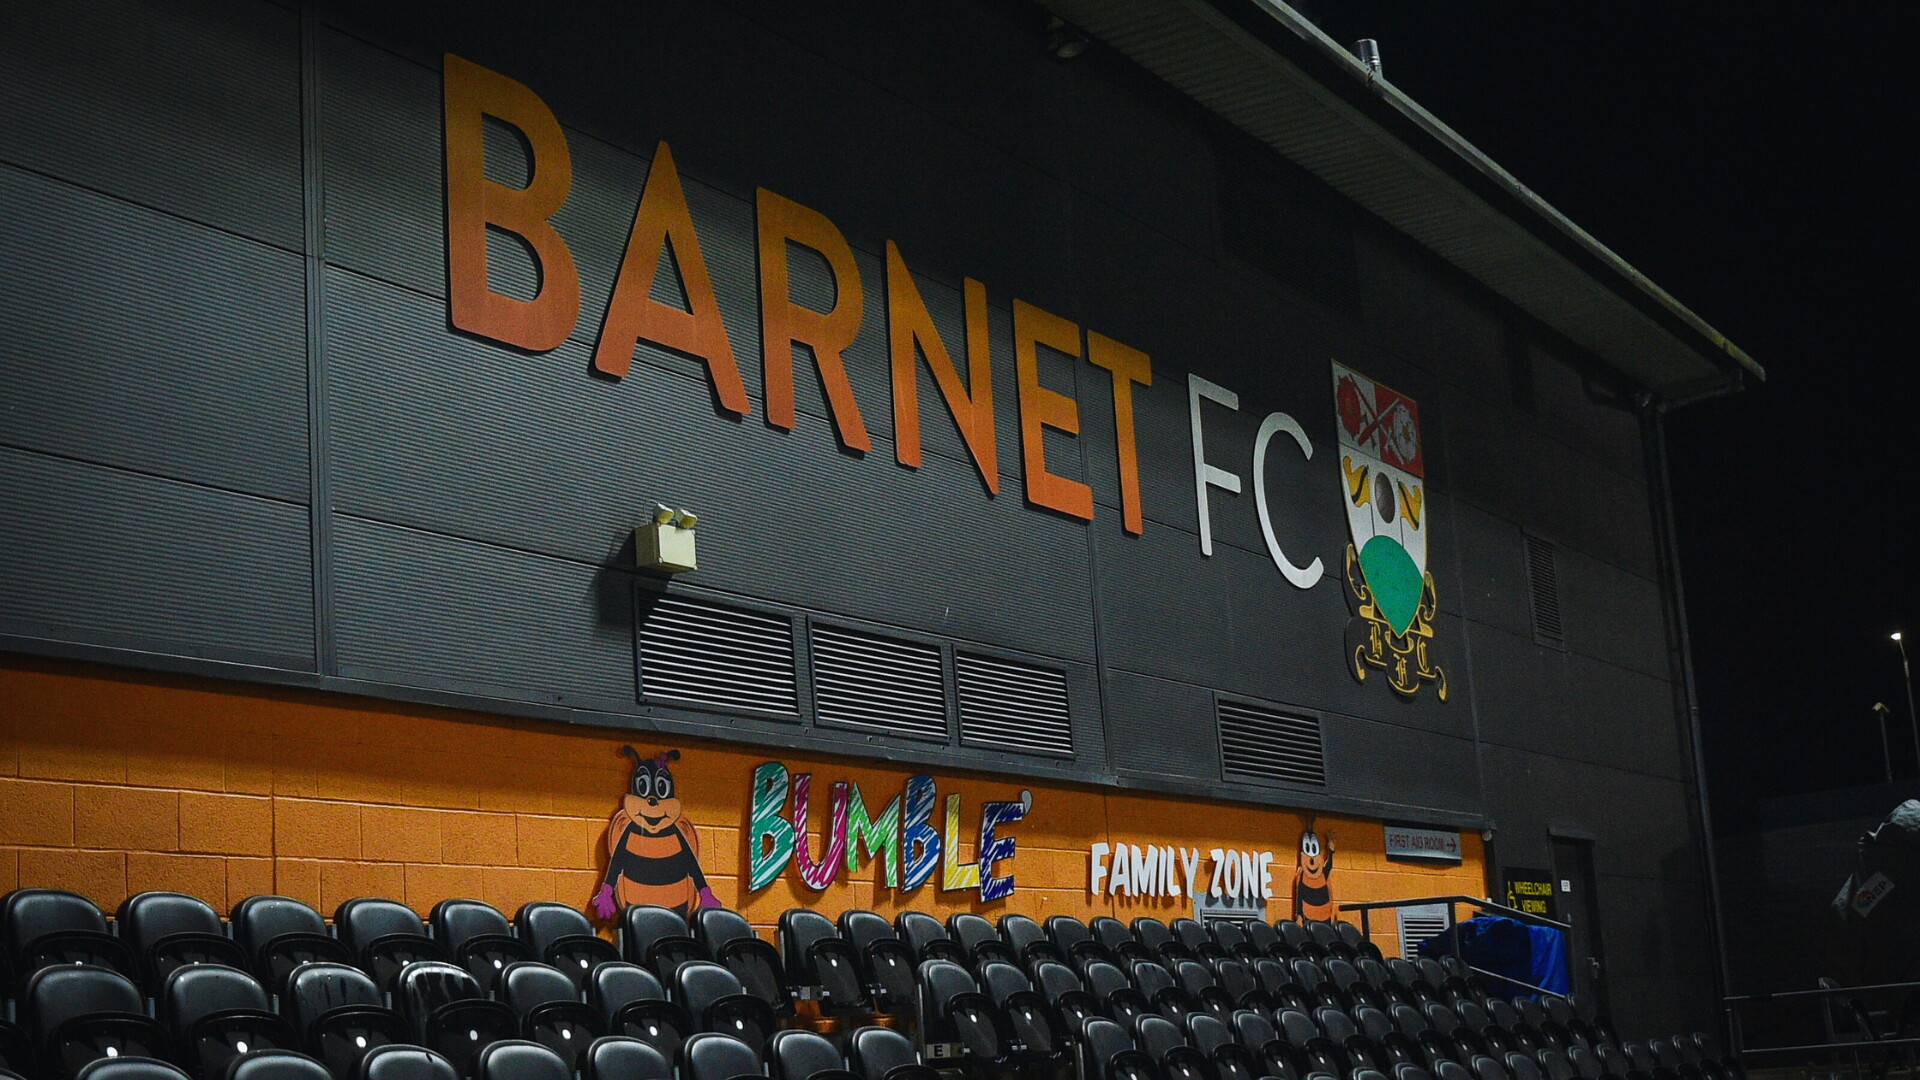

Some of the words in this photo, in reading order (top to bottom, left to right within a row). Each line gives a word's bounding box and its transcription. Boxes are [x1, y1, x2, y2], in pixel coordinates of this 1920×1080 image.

[442, 51, 1153, 538] BARNET
[1187, 372, 1325, 589] FC
[1390, 834, 1410, 848] FIRST
[1411, 836, 1423, 850] AID
[1424, 836, 1444, 850] ROOM
[1091, 841, 1199, 900] FAMILY
[1210, 848, 1274, 900] ZONE
[1514, 880, 1552, 896] WHEELCHAIR
[1522, 899, 1547, 914] VIEWING
[934, 1044, 943, 1057] E
